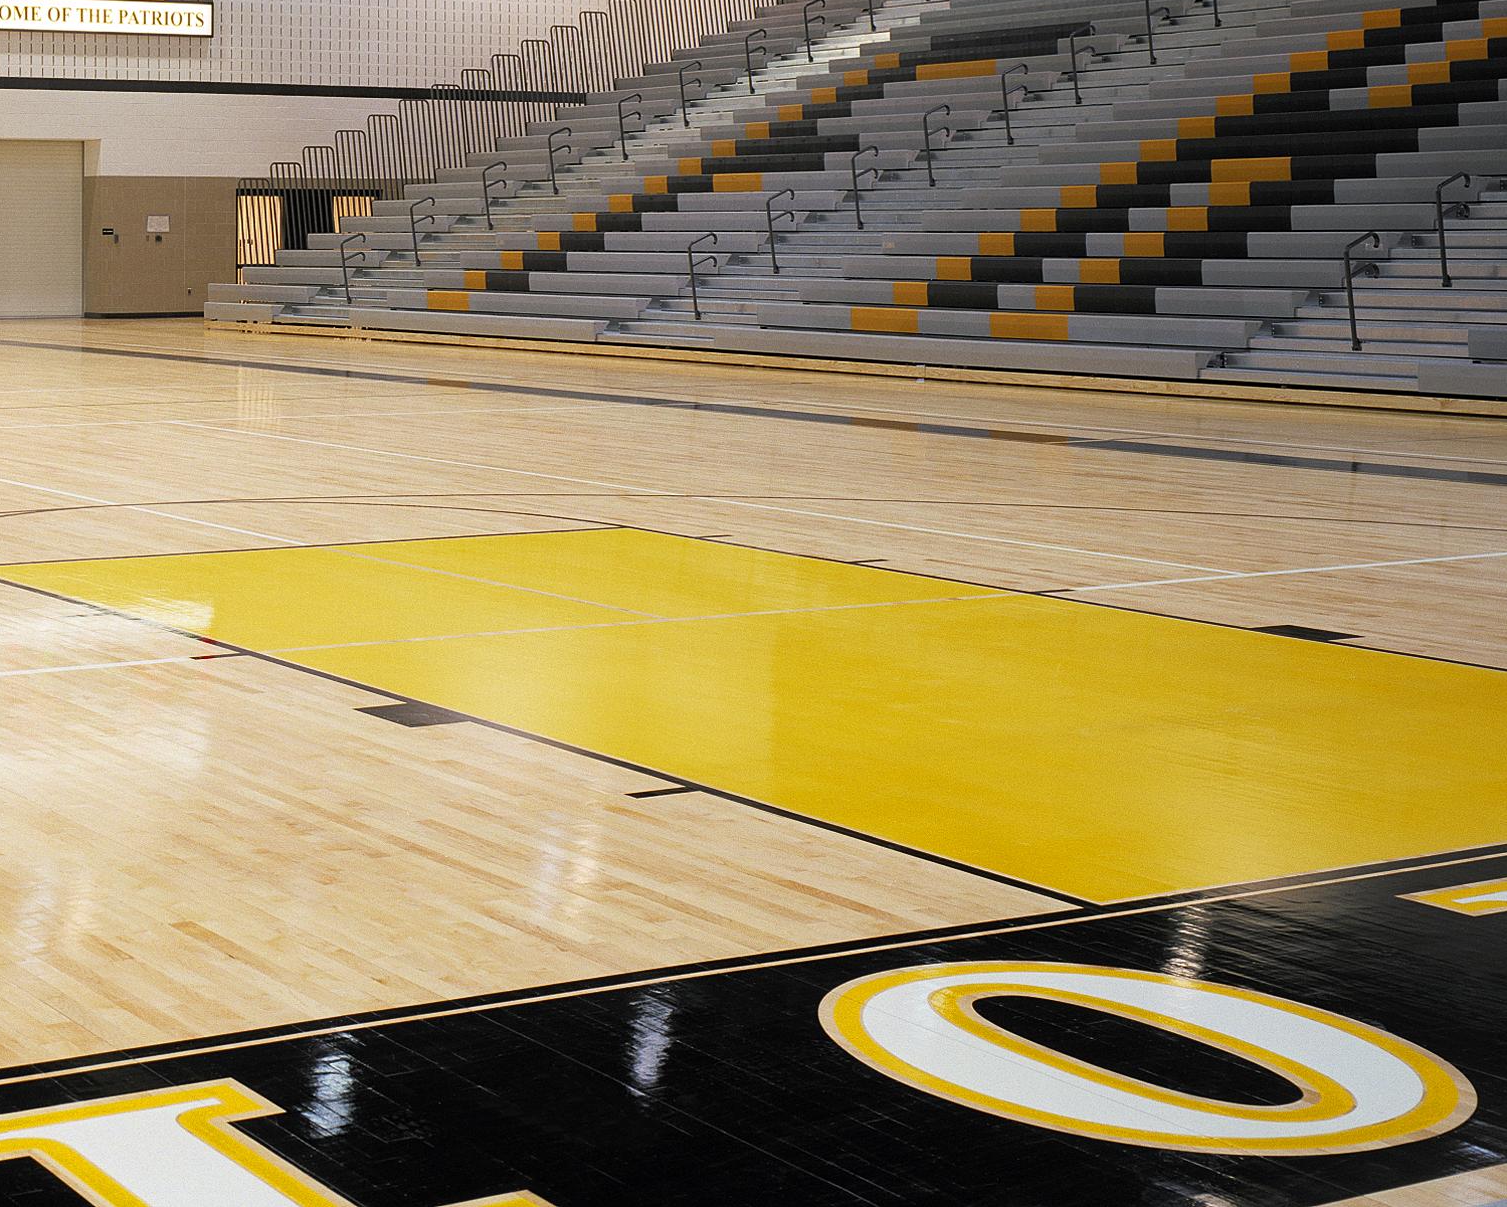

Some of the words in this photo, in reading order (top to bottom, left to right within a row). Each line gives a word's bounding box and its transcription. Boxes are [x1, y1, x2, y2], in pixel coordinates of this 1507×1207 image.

[47, 6, 72, 23] OF
[76, 7, 113, 24] THE
[118, 9, 205, 28] PATRIOTS
